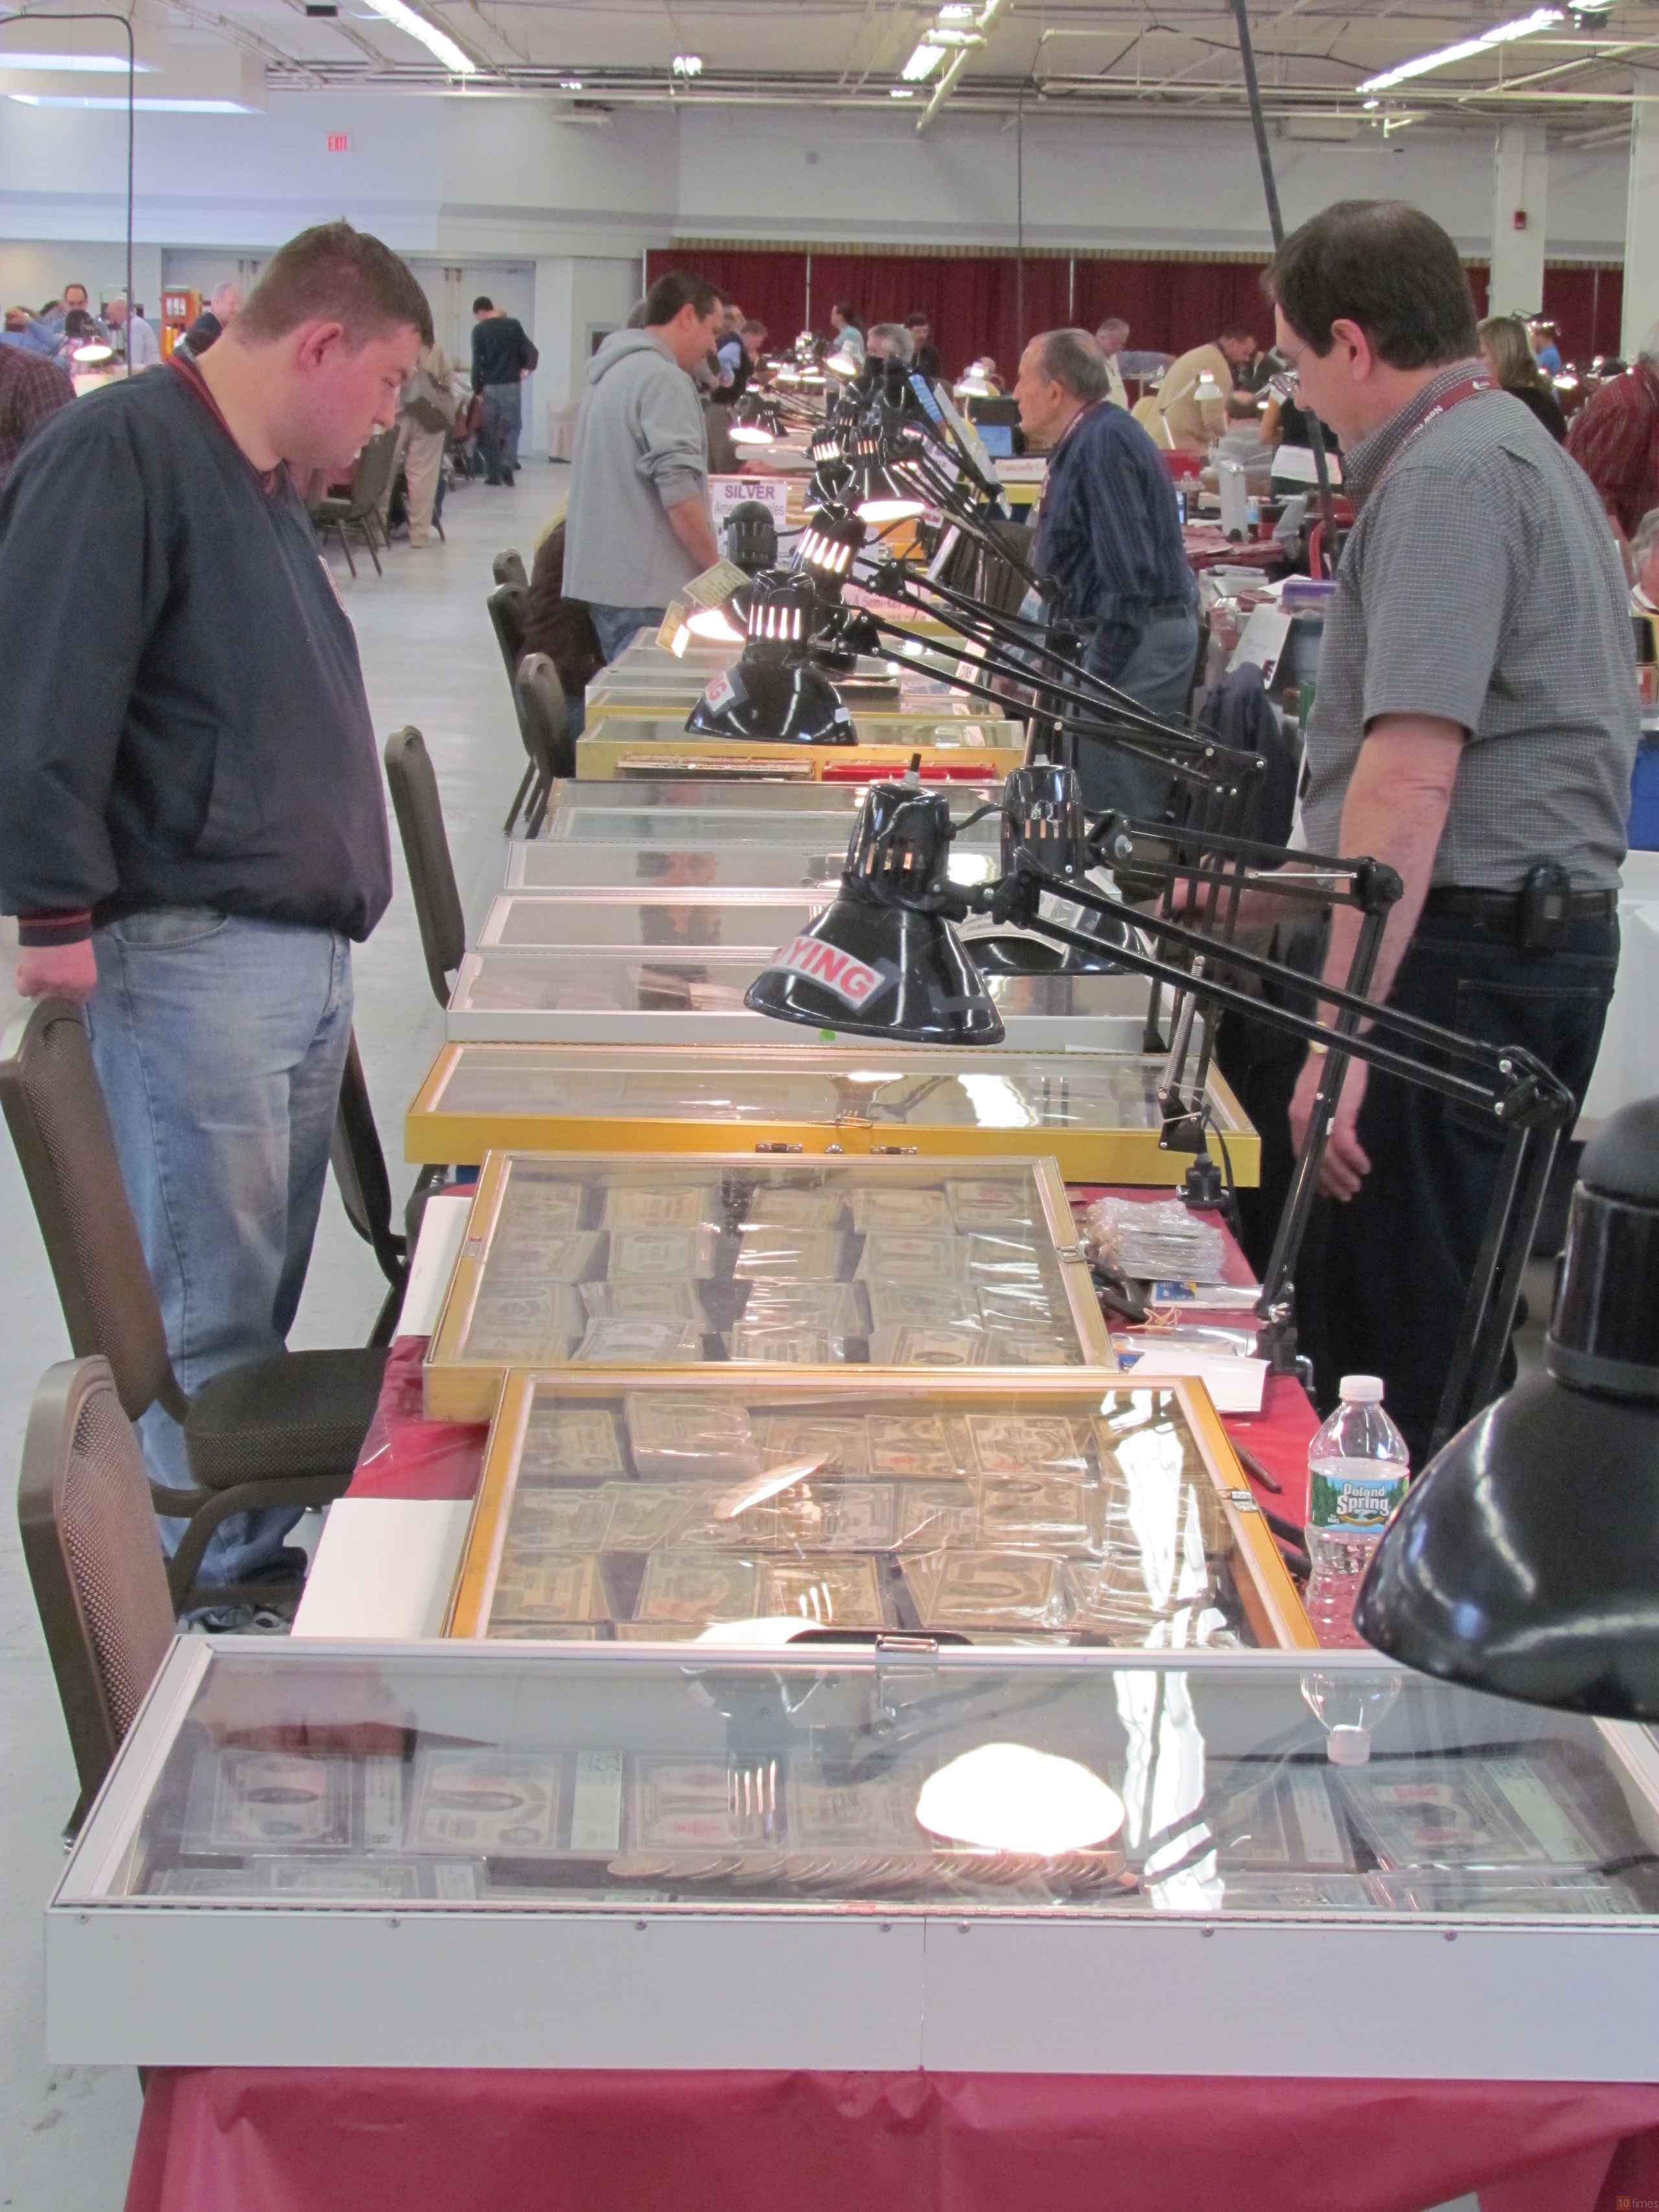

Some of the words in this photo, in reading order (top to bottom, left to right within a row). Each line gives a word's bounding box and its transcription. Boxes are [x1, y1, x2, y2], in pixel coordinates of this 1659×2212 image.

[328, 135, 348, 151] EXIT
[725, 484, 776, 500] SILVER
[774, 938, 875, 998] YING
[1343, 1483, 1385, 1497] Poland
[1336, 1495, 1390, 1517] Spring
